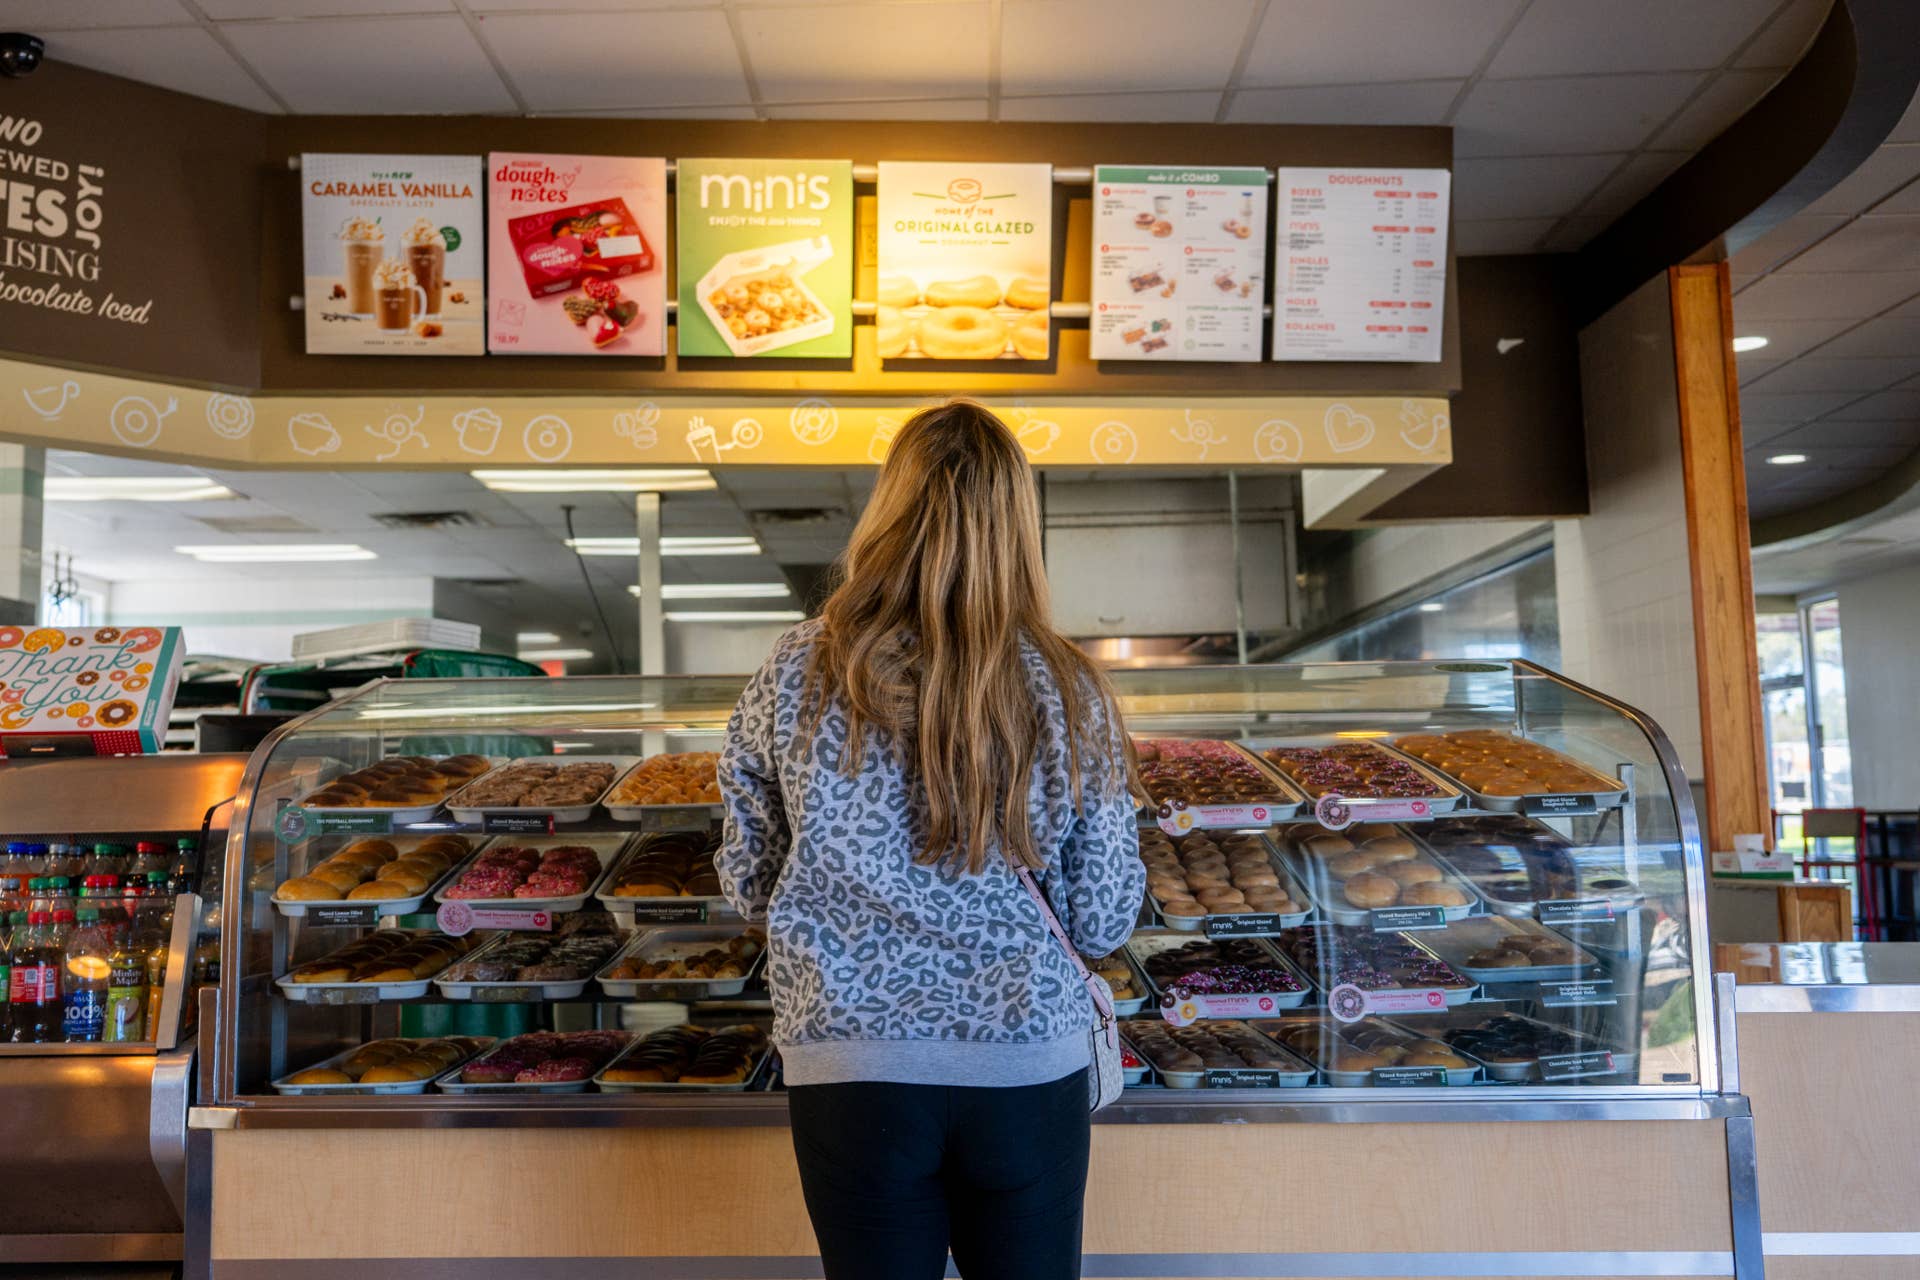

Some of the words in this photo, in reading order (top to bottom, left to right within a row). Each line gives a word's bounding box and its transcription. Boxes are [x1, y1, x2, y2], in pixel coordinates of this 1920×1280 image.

[1181, 172, 1220, 183] COMBO
[1328, 175, 1403, 186] DOUGHNUTS
[310, 181, 397, 197] CARAMEL
[401, 182, 473, 198] VANILLA
[700, 172, 831, 213] minis
[75, 164, 104, 250] JOY!
[963, 205, 977, 218] of
[977, 208, 994, 216] THE
[894, 220, 971, 234] ORIGINAL
[973, 221, 1035, 235] GLAZED
[97, 292, 153, 325] Iced
[0, 639, 141, 677] Thank
[11, 674, 120, 718] You
[64, 1005, 105, 1020] 100%
